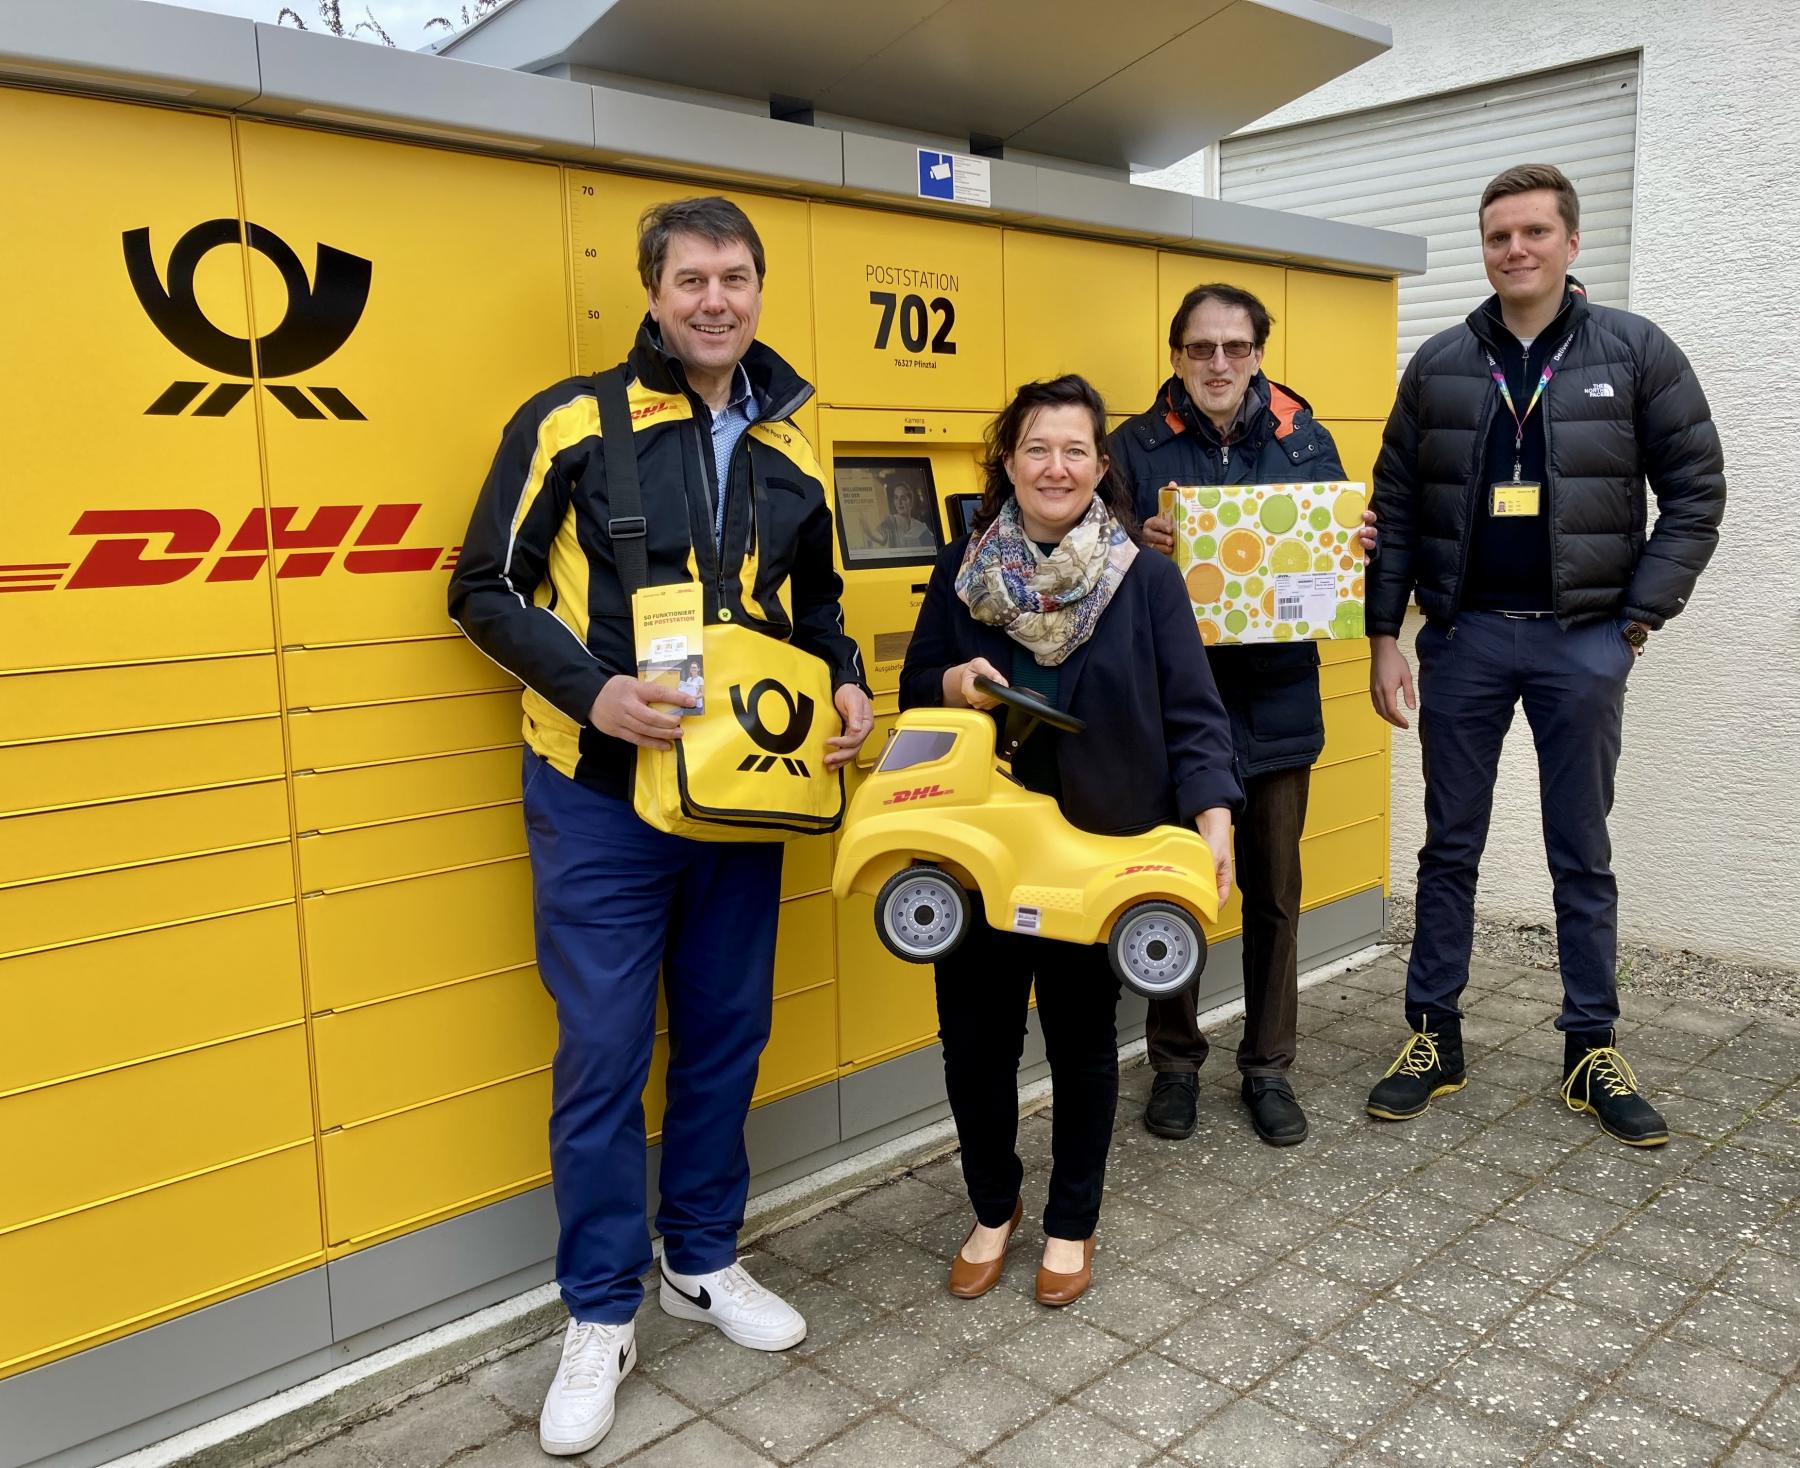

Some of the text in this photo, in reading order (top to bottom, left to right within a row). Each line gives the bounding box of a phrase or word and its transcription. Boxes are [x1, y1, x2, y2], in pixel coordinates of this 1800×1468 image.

[581, 185, 594, 196] 70
[584, 248, 597, 258] 60
[865, 264, 959, 292] POSTSTATION
[587, 310, 600, 320] 50
[869, 290, 957, 355] 702
[894, 359, 937, 369] 76327 Pfinztal
[631, 401, 669, 420] DHL
[64, 503, 444, 590] DHL
[652, 609, 696, 619] FUNKTIONIERT
[654, 616, 695, 625] POSTSTATION
[891, 784, 946, 804] DHL
[1123, 864, 1177, 875] DHL
